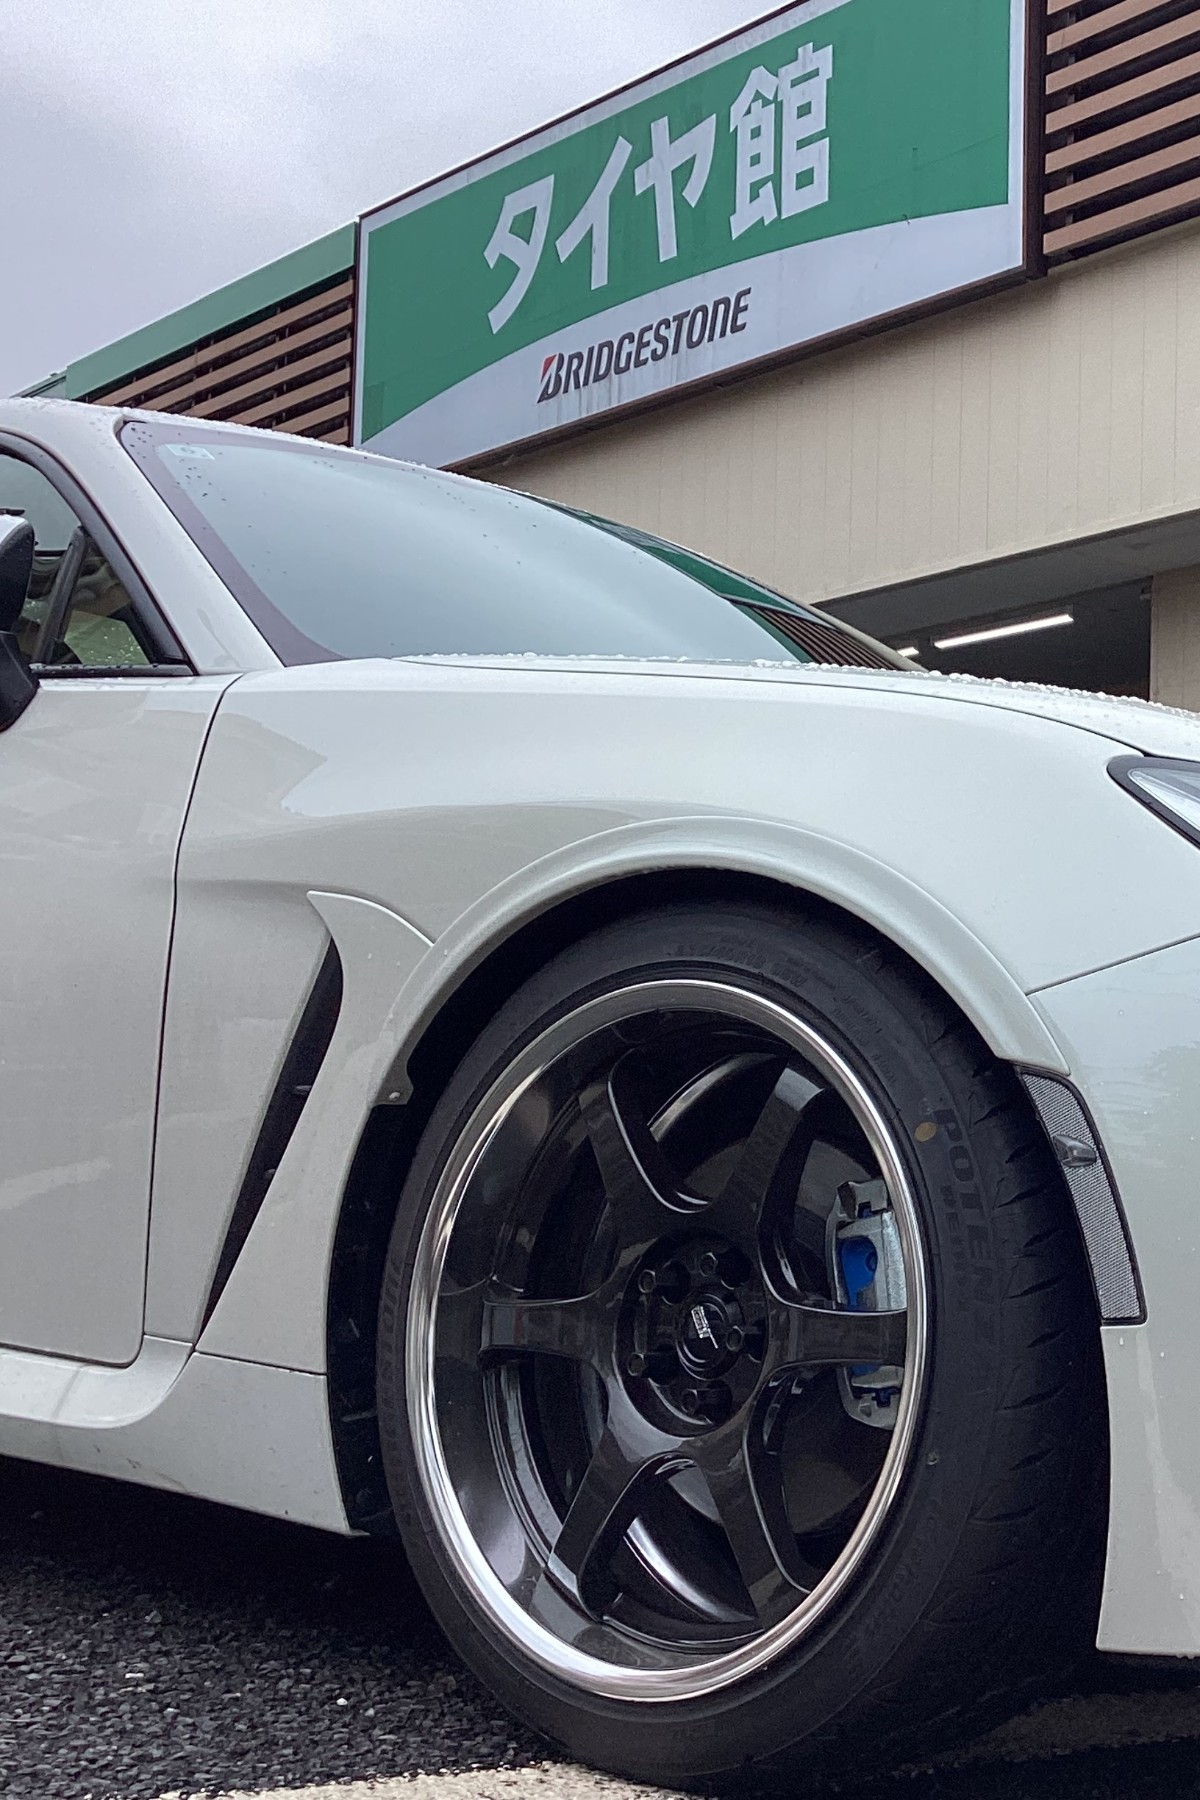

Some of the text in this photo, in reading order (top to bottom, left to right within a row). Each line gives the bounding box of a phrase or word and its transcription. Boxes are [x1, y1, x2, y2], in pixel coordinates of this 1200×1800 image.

[484, 41, 834, 335] タイヤ館
[536, 287, 752, 403] BRIDGESTONE
